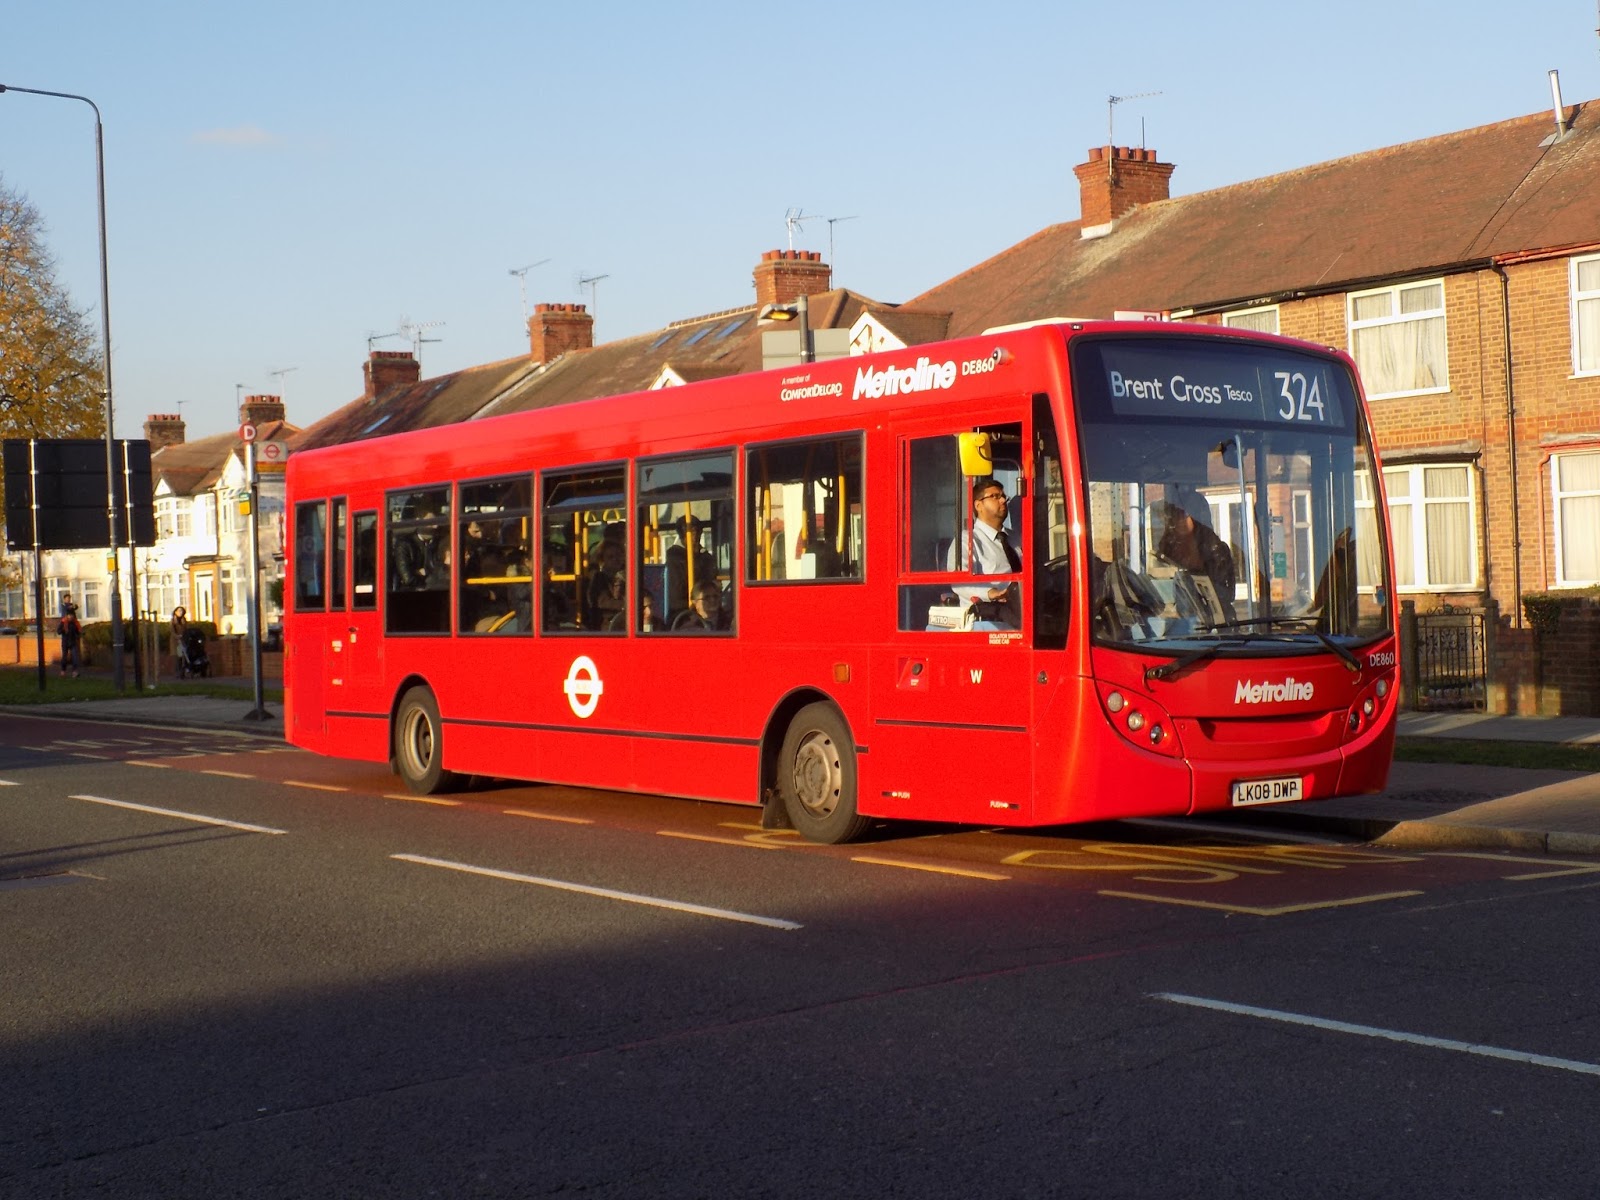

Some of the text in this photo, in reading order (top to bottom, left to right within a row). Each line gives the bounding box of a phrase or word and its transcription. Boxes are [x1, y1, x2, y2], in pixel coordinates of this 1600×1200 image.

[849, 356, 957, 401] Metroline
[961, 359, 996, 377] DE860
[1110, 370, 1253, 404] Brent Cross Tesco
[1274, 371, 1325, 422] 324
[243, 424, 256, 441] D
[1369, 652, 1395, 668] DE860
[970, 669, 983, 684] W
[1234, 677, 1314, 704] Metroline
[1238, 781, 1298, 802] LK08 DWP
